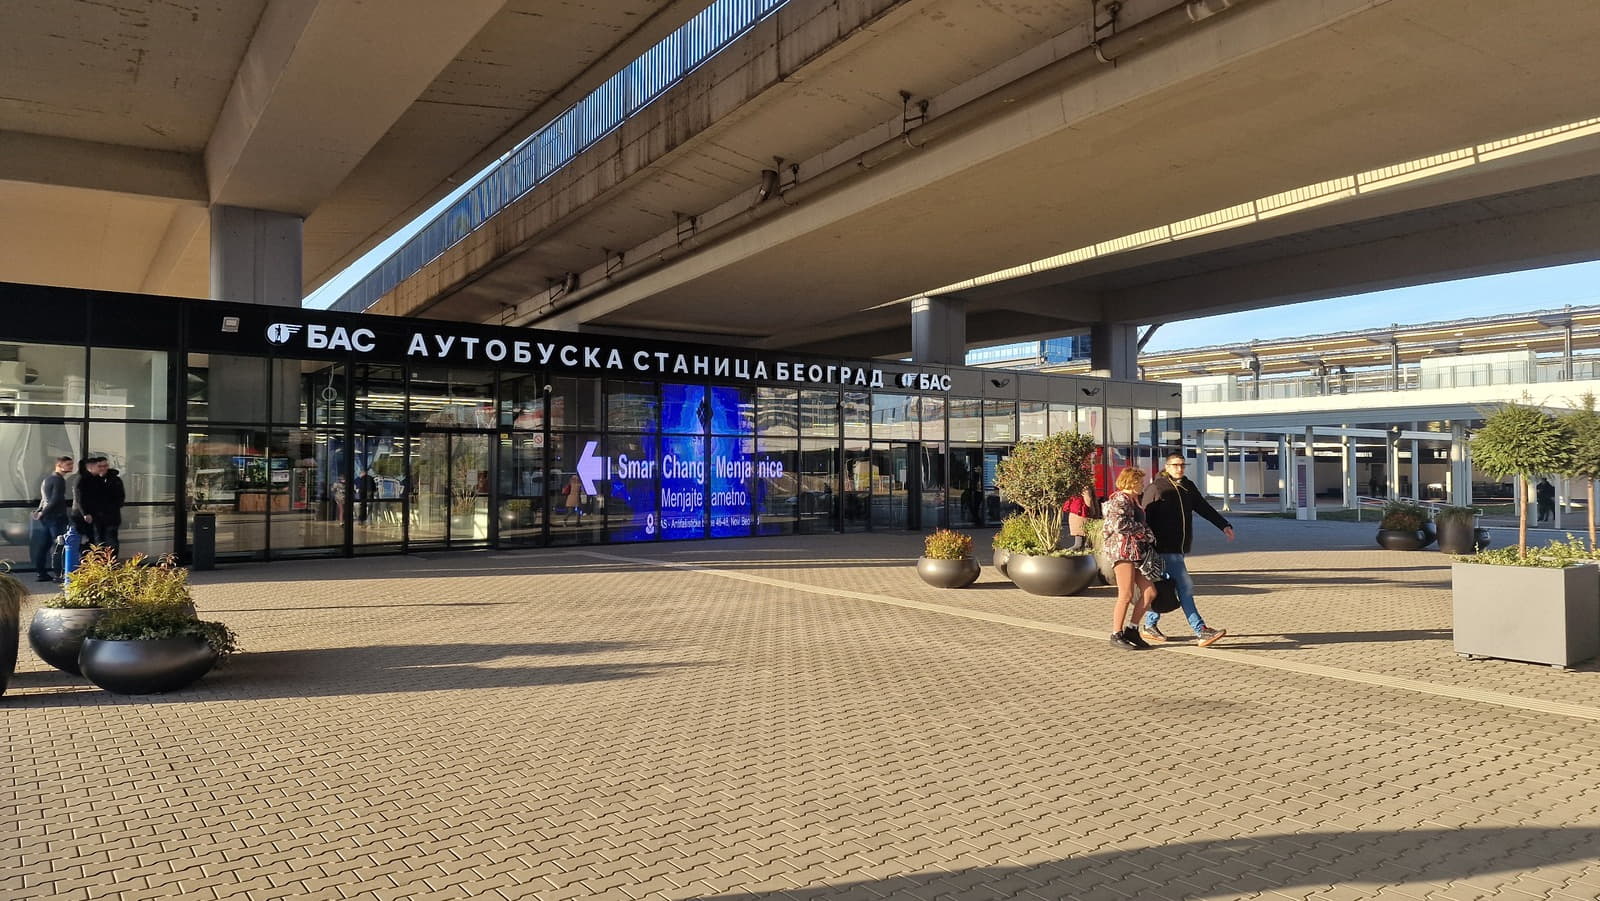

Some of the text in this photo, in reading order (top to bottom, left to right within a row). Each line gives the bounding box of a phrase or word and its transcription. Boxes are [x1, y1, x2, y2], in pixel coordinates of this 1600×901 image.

[307, 325, 376, 352] БАС
[407, 332, 884, 389] АУТОБУСКА СТАНИЦА БЕОГРАД
[919, 373, 952, 391] БАС
[618, 454, 783, 485] Smar Chang Menjanice
[661, 488, 746, 512] Menjajte ametno
